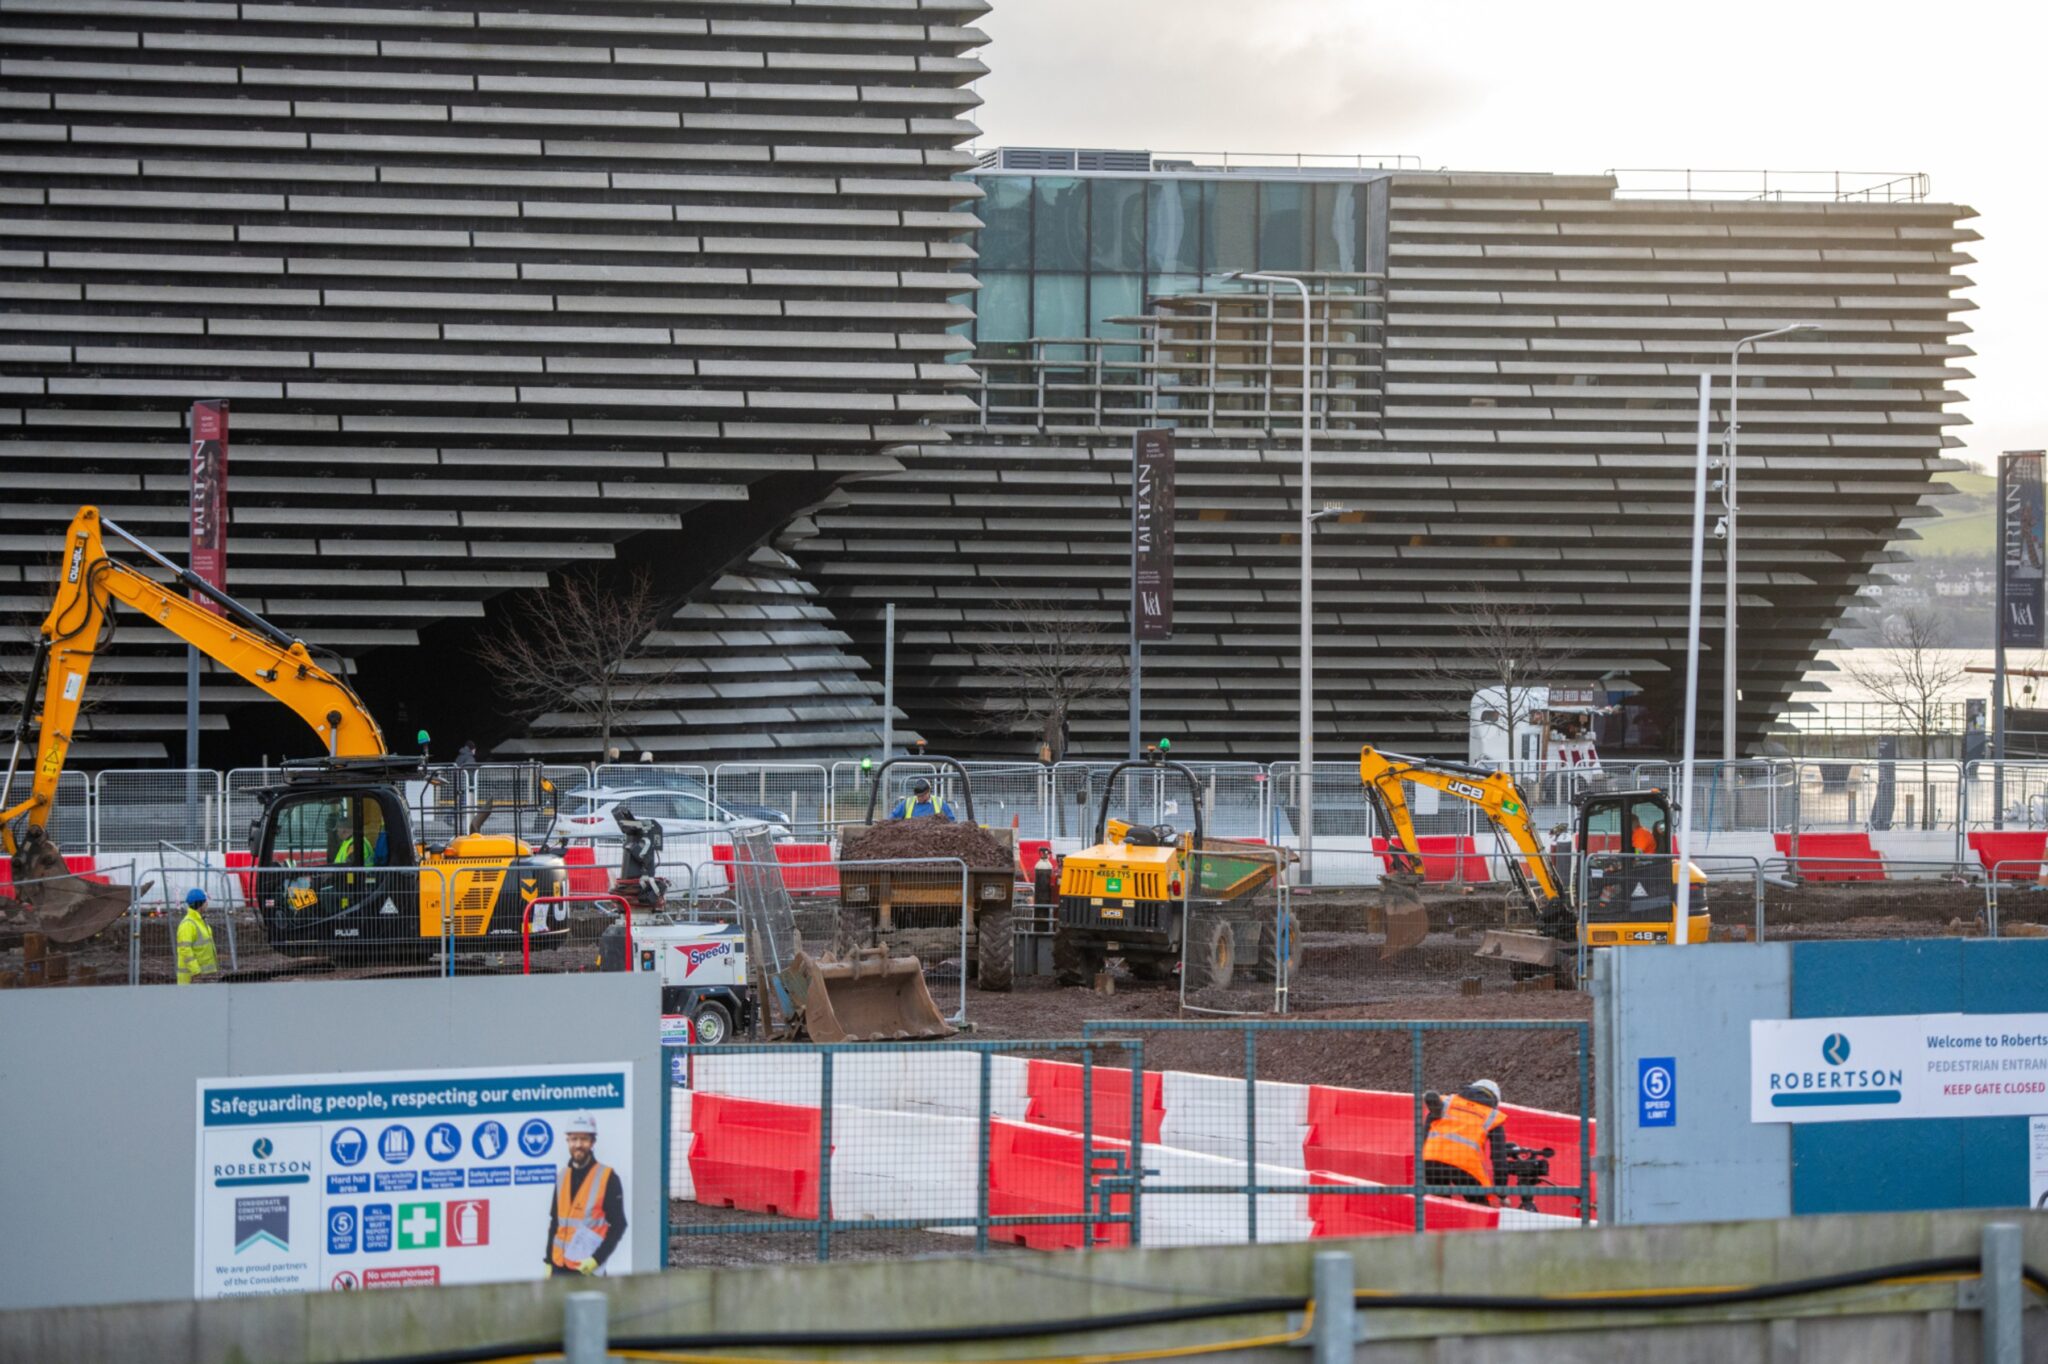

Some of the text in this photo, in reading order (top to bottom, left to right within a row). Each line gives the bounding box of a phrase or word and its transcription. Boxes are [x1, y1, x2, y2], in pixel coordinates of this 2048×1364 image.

[1138, 464, 1151, 552] TARTAN
[1141, 591, 1161, 616] V&A
[2010, 602, 2034, 625] V&A
[1447, 781, 1484, 800] JCB
[292, 890, 318, 908] JCB
[691, 943, 730, 964] Speedy
[1927, 1034, 2048, 1048] Welcome to Roberts
[1927, 1058, 2047, 1072] PEDESTRIAN ENTRAN
[1651, 1072, 1664, 1093] 5
[1771, 1070, 1902, 1089] ROBERTSON
[1944, 1082, 2046, 1095] KEEP GATE CLOSED
[211, 1083, 619, 1116] Safeguarding people, respecting our environment.
[1645, 1101, 1670, 1109] SPEED
[1648, 1110, 1667, 1119] LIMIT
[214, 1161, 311, 1176] ROBERTSON
[353, 1175, 366, 1183] hat
[337, 1216, 348, 1231] 5
[216, 1266, 228, 1274] We
[246, 1263, 270, 1273] proud
[273, 1263, 307, 1272] partners
[381, 1269, 434, 1279] unauthorised
[250, 1275, 299, 1284] Considerate
